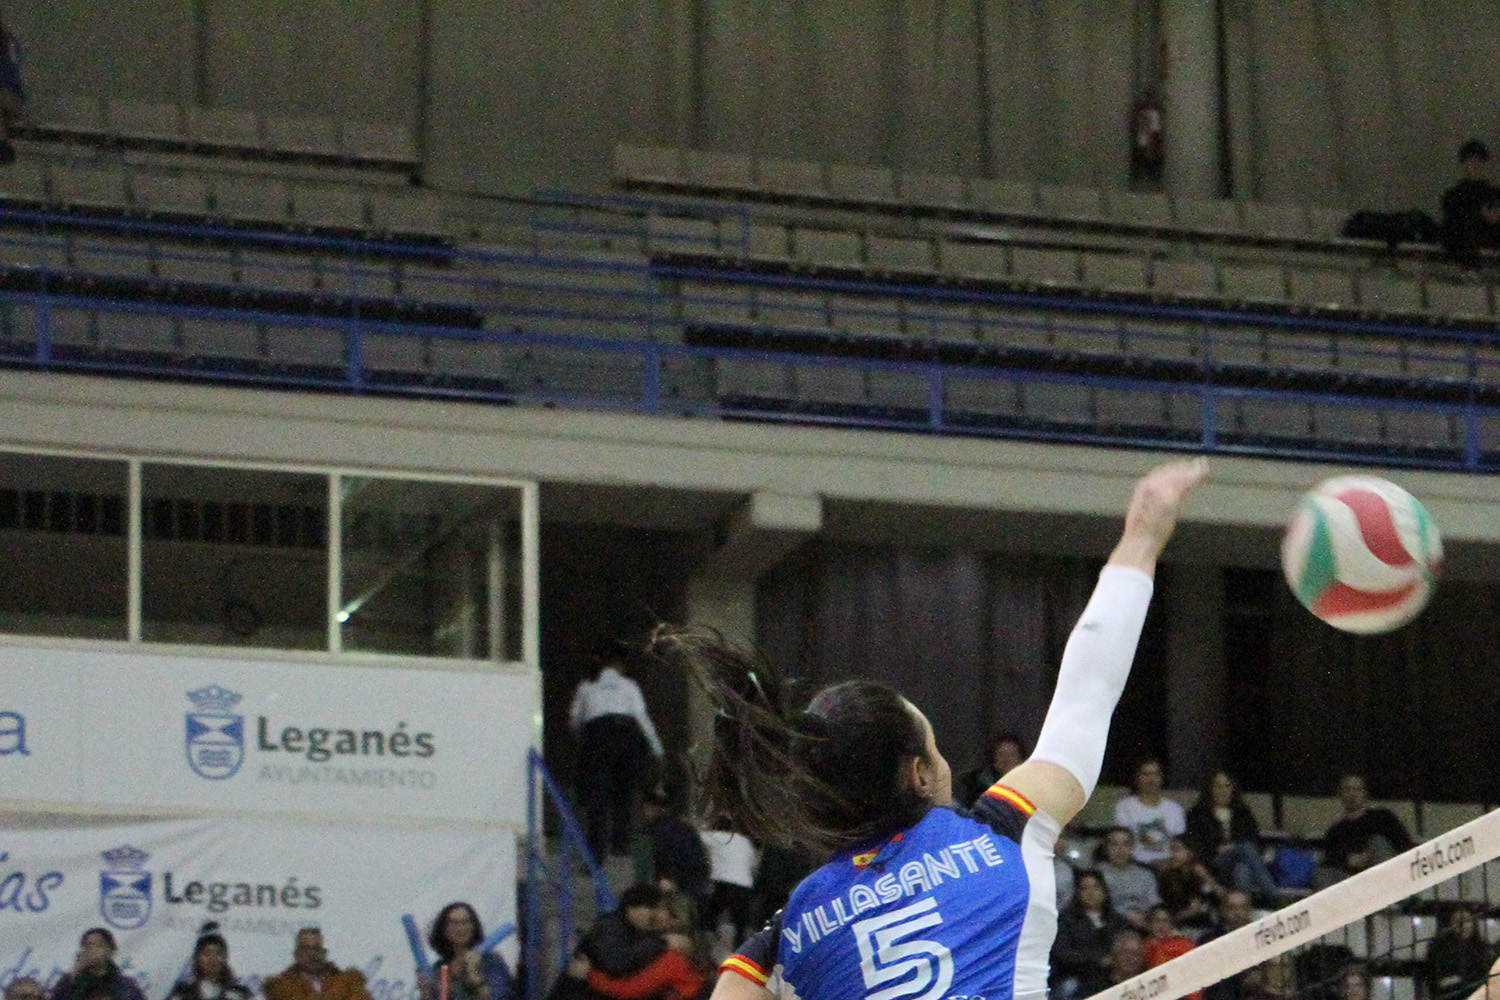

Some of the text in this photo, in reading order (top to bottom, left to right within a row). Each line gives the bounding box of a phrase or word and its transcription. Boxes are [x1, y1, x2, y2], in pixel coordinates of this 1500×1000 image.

[257, 715, 436, 763] Leganés
[258, 765, 437, 790] AYUNTAMIENTO
[1410, 836, 1475, 882] rfevb.com
[164, 871, 322, 912] Leganés
[783, 833, 1004, 954] VILLASANTE
[1254, 908, 1312, 950] rfevb.com
